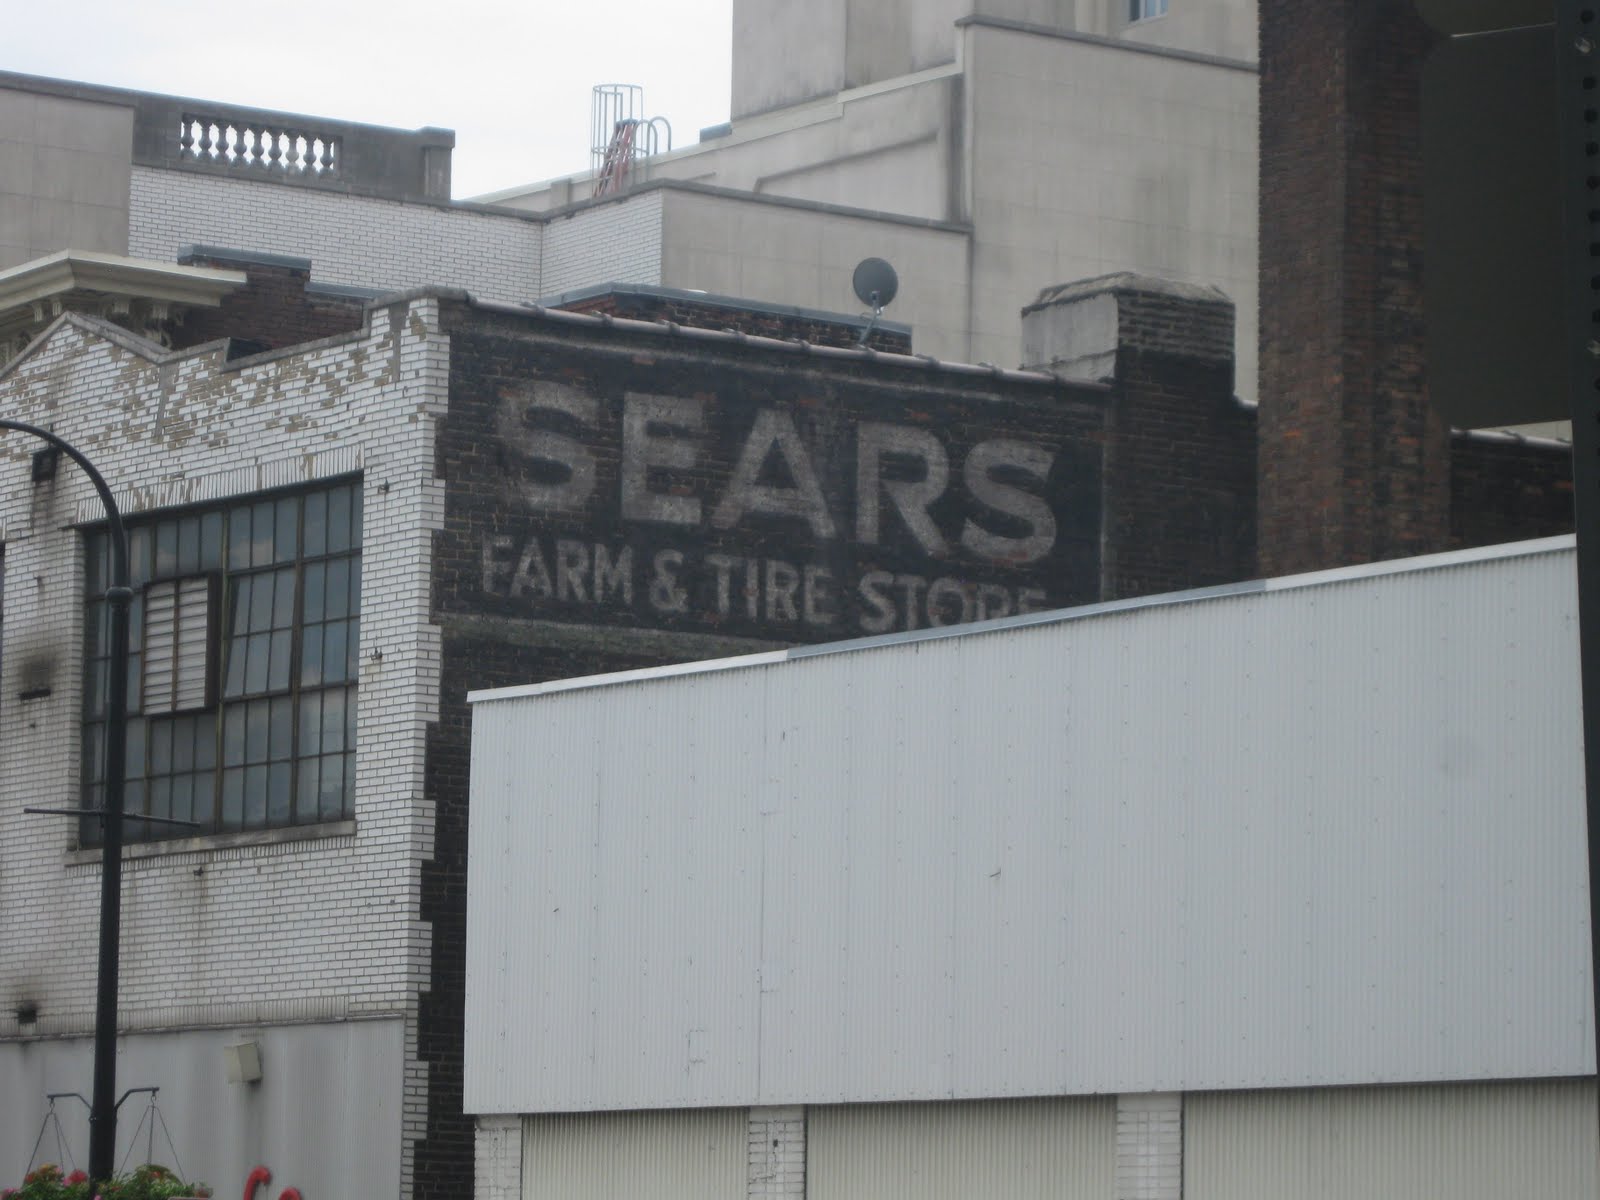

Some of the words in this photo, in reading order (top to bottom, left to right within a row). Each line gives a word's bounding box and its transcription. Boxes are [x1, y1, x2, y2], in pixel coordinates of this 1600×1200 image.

[496, 380, 1058, 565] SEARS
[482, 537, 633, 604] FARM
[650, 549, 688, 612] &
[704, 554, 833, 624] TIRE
